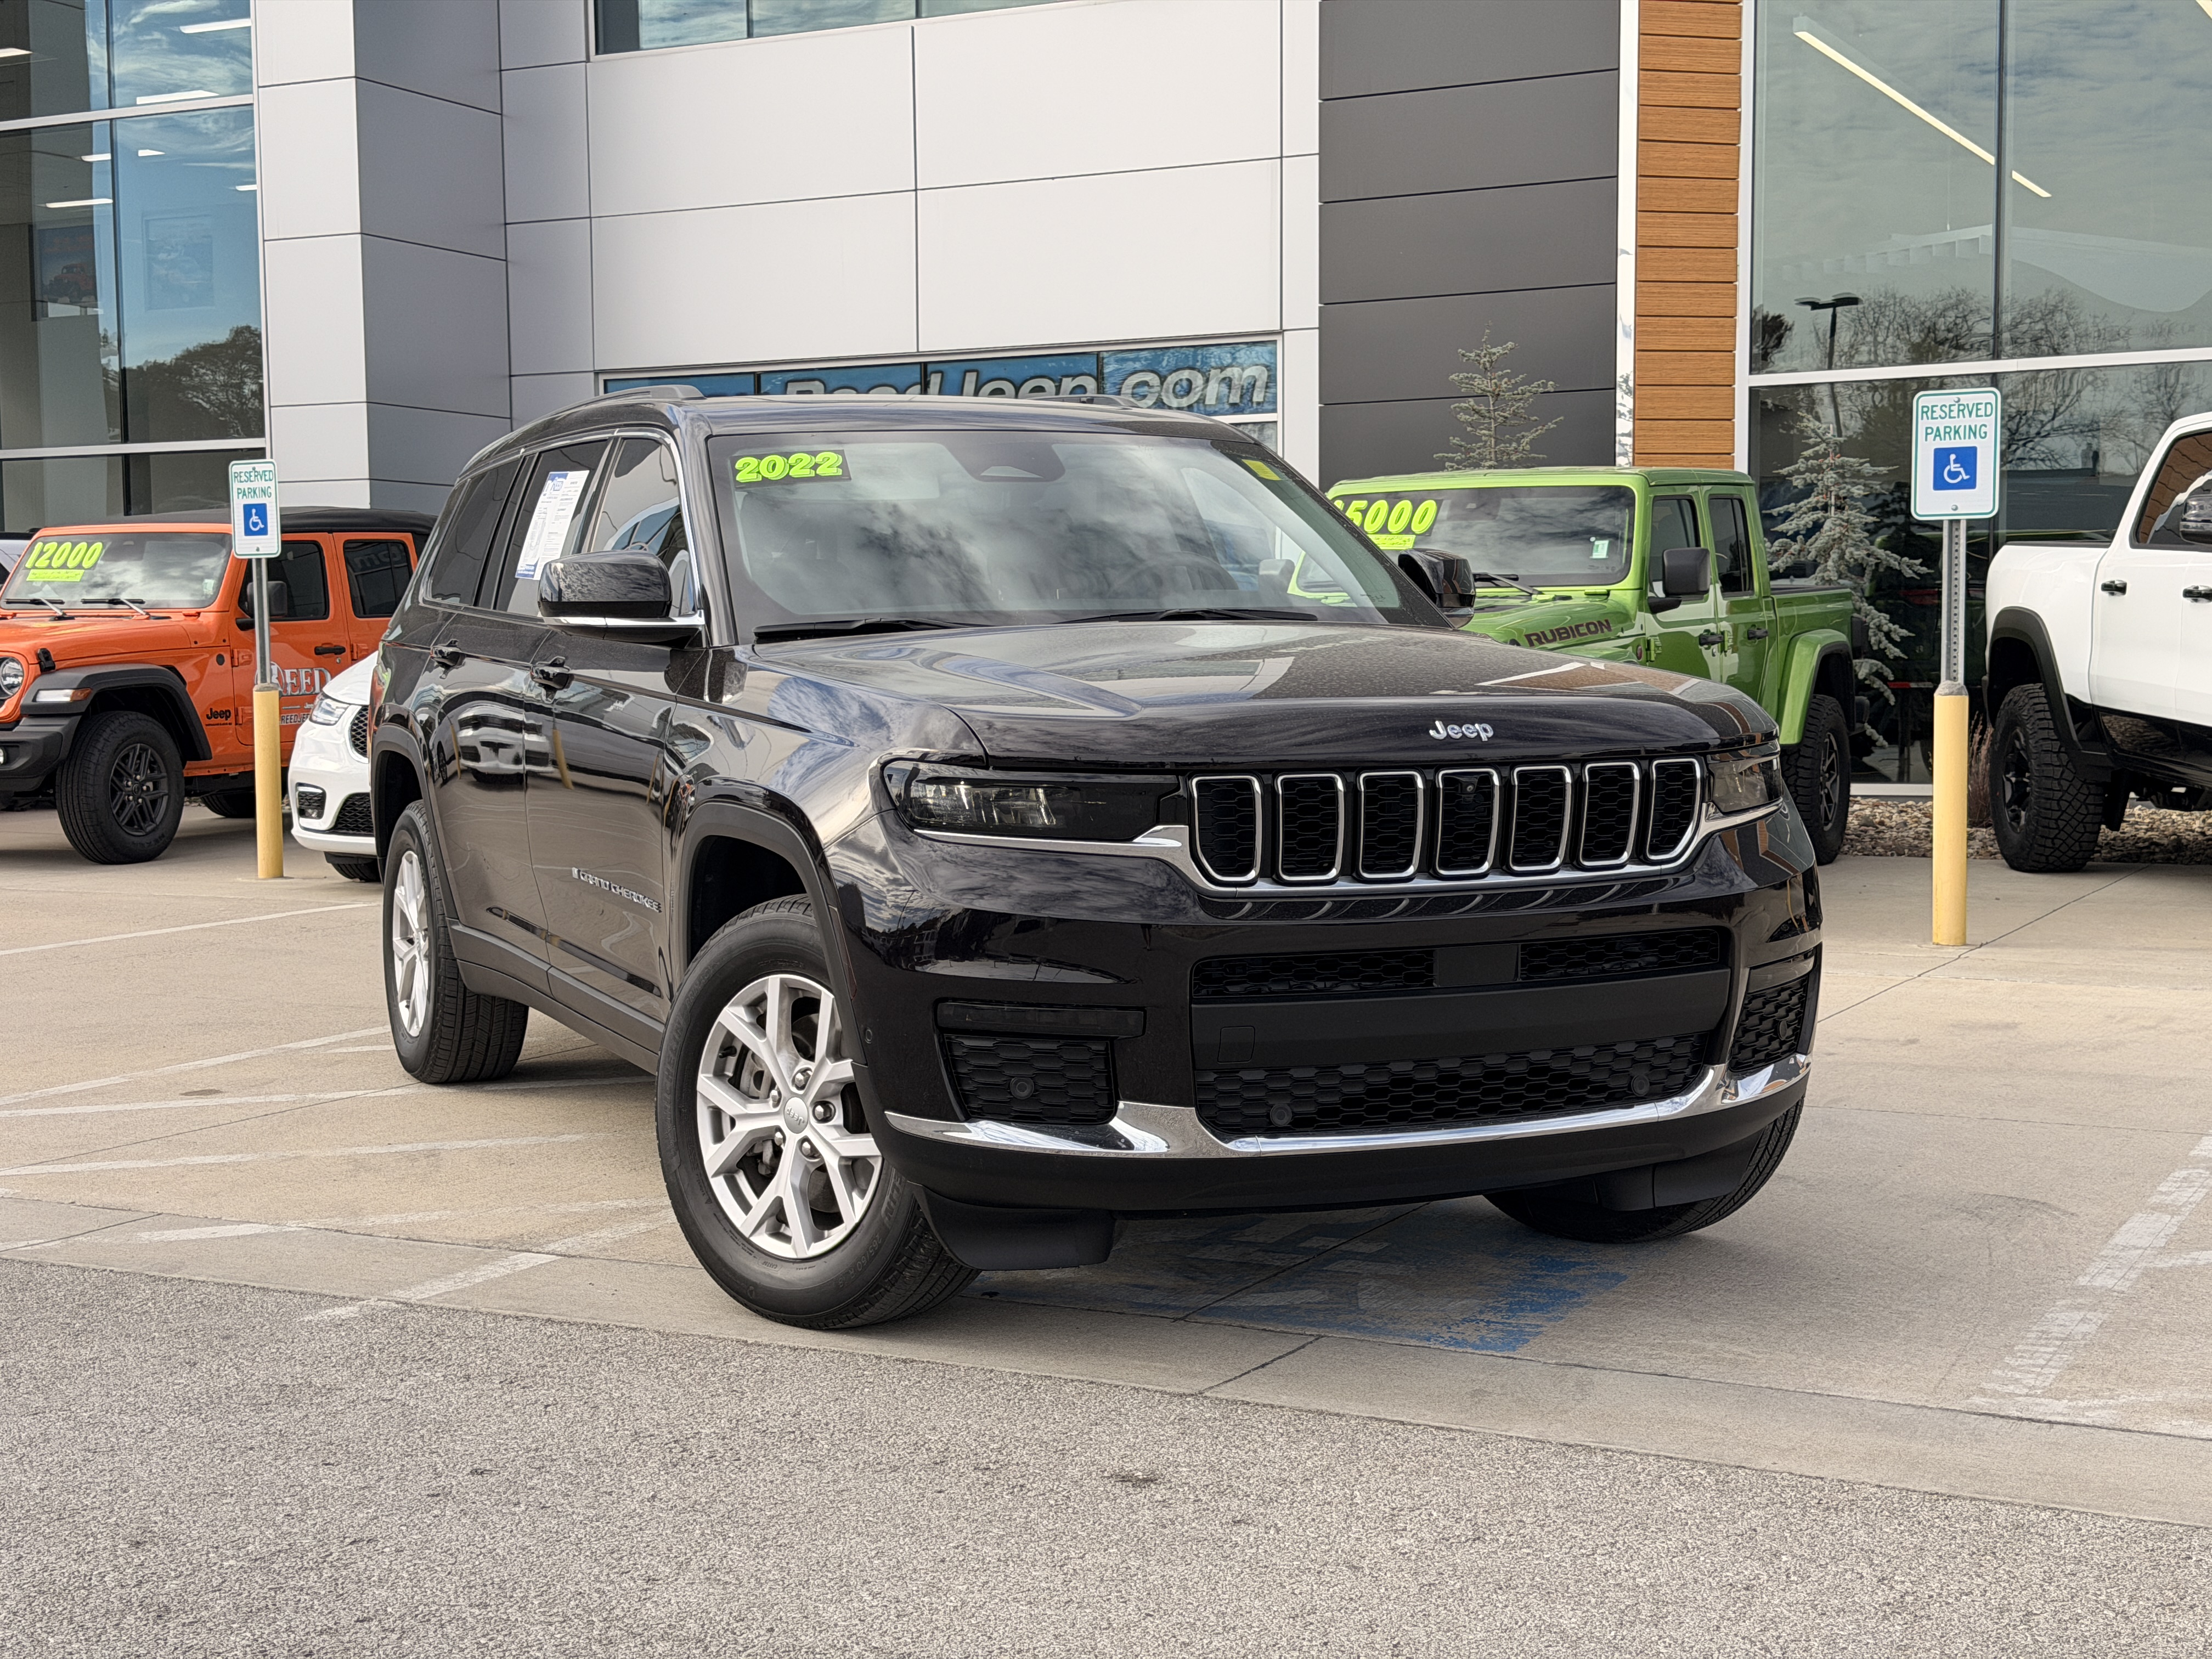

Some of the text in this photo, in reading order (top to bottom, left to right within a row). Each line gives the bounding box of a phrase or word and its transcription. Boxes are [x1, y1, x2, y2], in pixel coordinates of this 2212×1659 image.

[1921, 402, 1993, 420] RESERVED
[1925, 424, 1987, 442] PARKING
[233, 470, 273, 483] RESERVED
[735, 452, 843, 483] 2022
[237, 486, 272, 499] PARKING
[25, 542, 103, 568] 12000
[1524, 619, 1612, 647] RUBICON
[206, 708, 232, 721] Jeep
[1429, 720, 1494, 741] Jeep
[611, 882, 661, 913] CHEROKEE
[786, 1106, 805, 1126] Jeep
